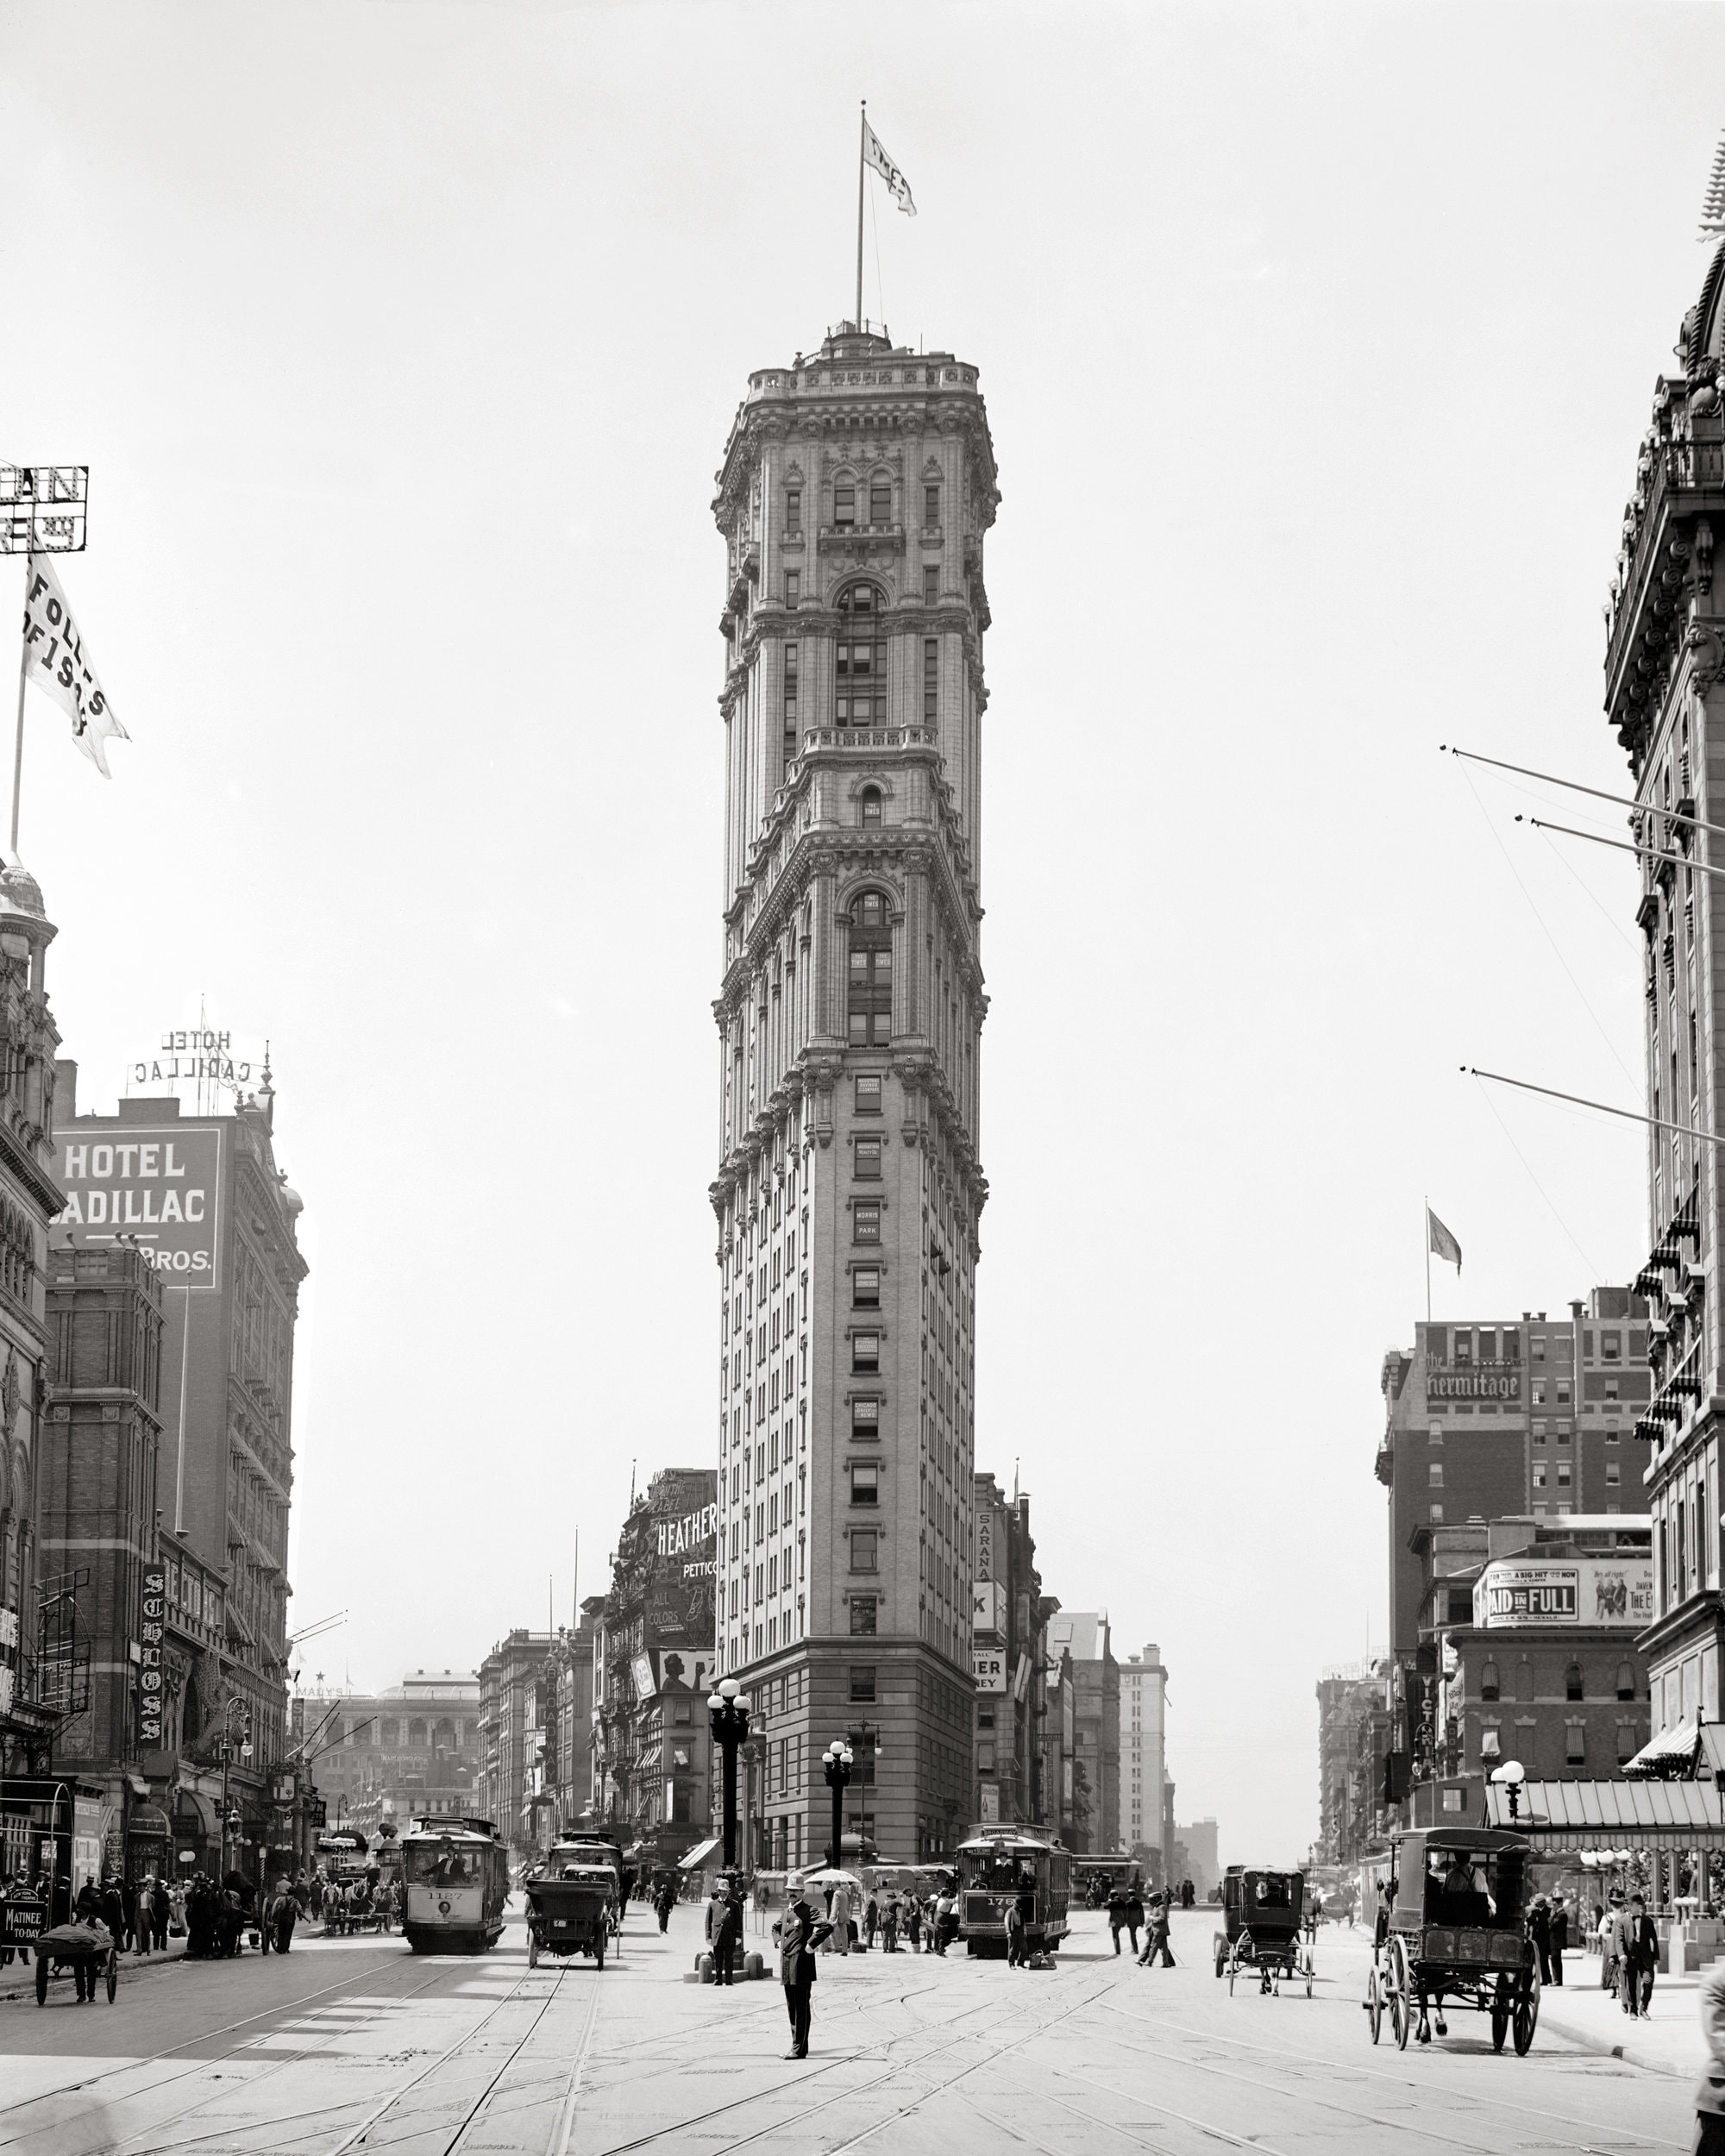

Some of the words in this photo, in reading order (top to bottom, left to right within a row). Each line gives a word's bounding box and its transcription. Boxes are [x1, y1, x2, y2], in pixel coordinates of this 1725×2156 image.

[65, 1144, 185, 1179] HOTEL
[50, 1190, 204, 1225] ADILLAC
[141, 1247, 211, 1271] BROS.
[1427, 1351, 1442, 1367] the
[658, 1502, 717, 1556] HEATHER
[653, 1592, 669, 1606] ALL
[1490, 1589, 1513, 1614] AID
[1515, 1596, 1527, 1605] IN
[1529, 1589, 1573, 1612] FULL
[649, 1611, 678, 1625] COLORS
[141, 1573, 164, 1739] SCHLOSS
[298, 1687, 343, 1696] MACY'S
[547, 1668, 556, 1780] BROADWAY
[1421, 1676, 1433, 1769] VICTORIA
[5, 1908, 41, 1931] MATINEE
[14, 1927, 41, 1939] TO-DAY
